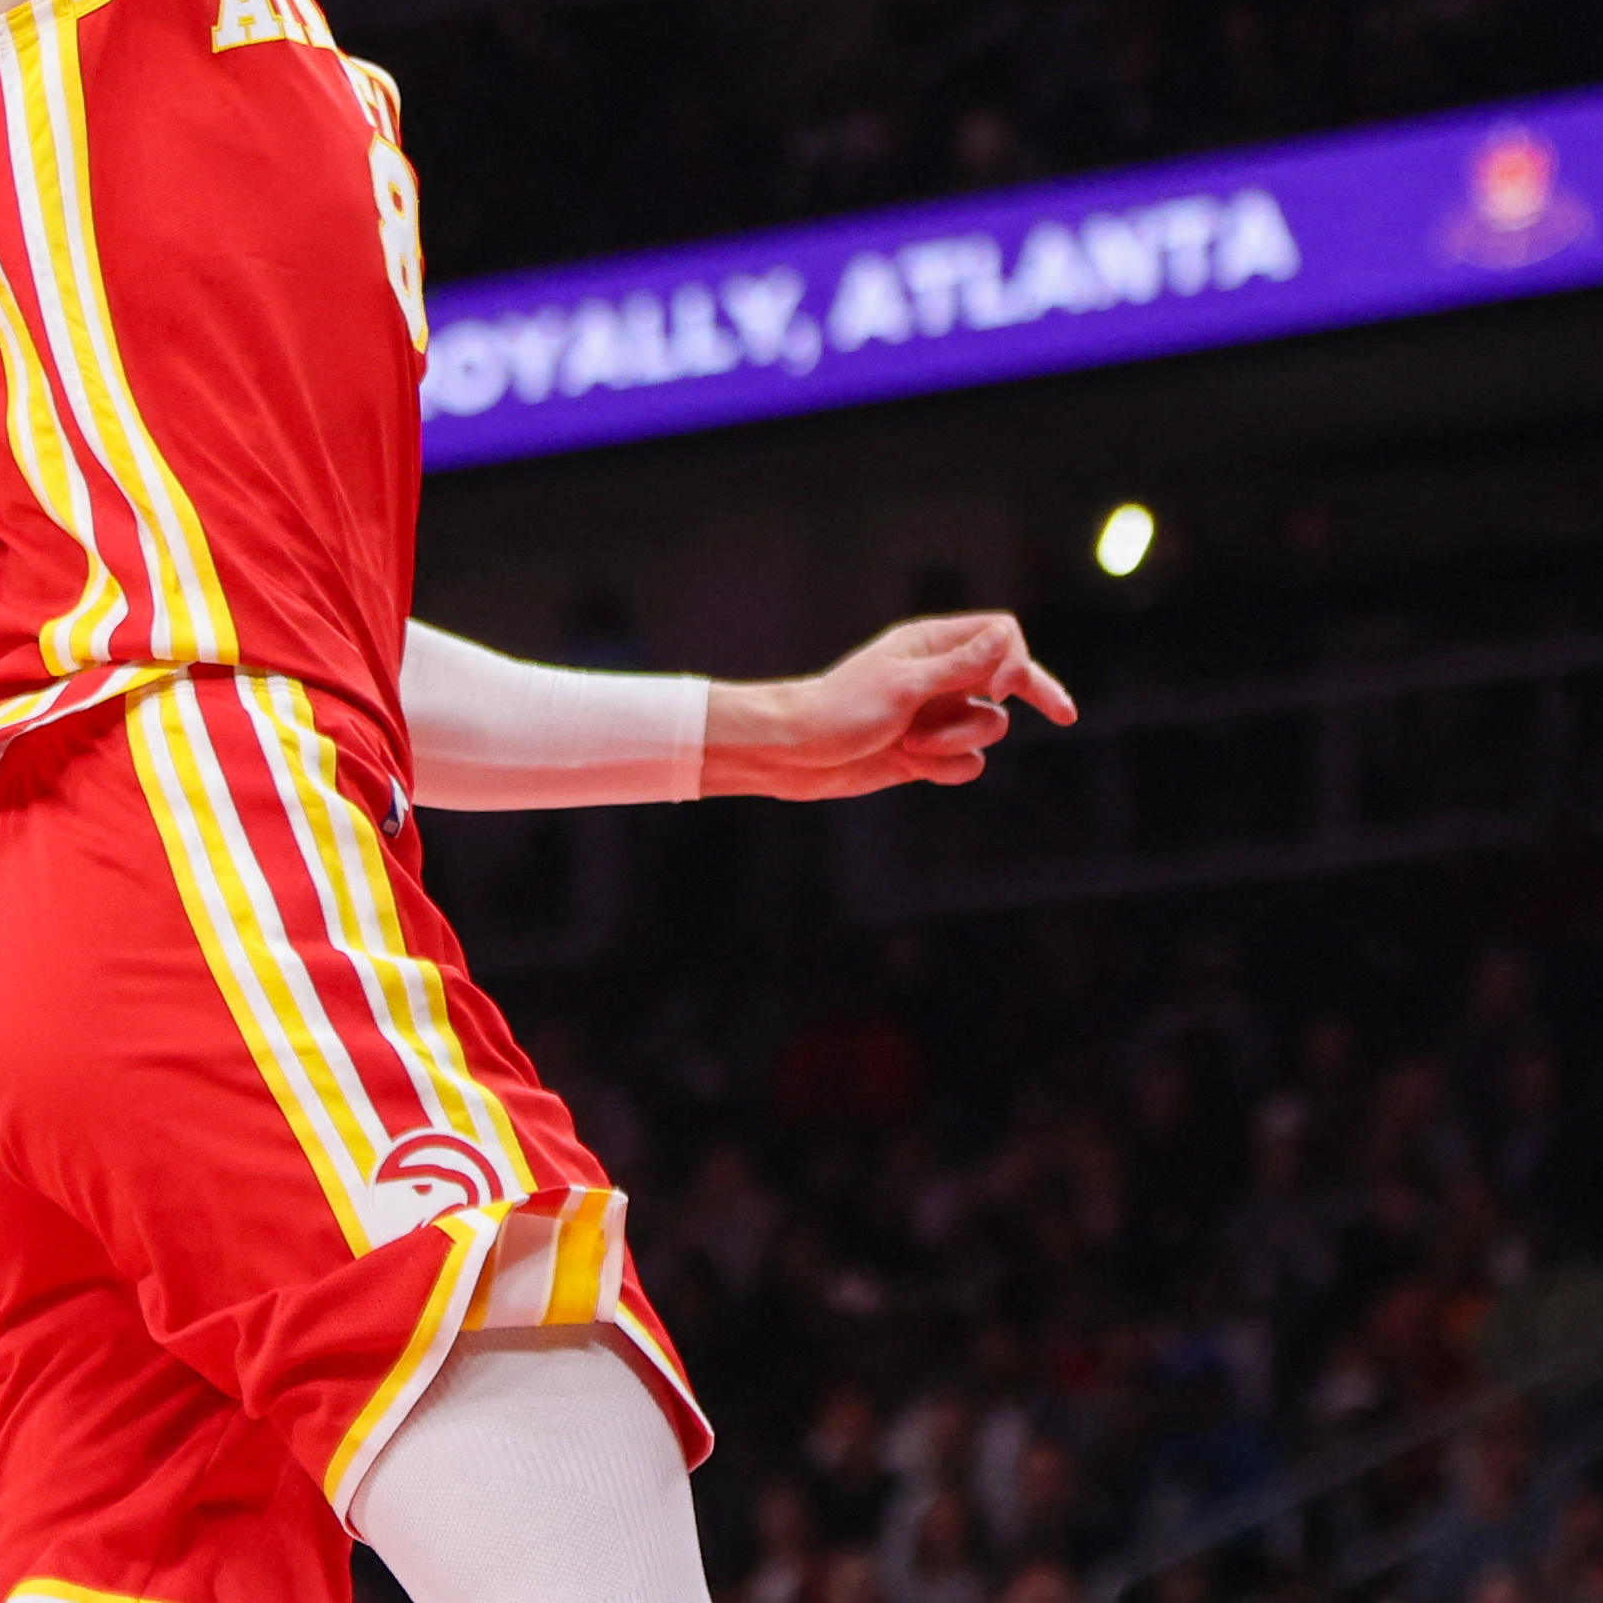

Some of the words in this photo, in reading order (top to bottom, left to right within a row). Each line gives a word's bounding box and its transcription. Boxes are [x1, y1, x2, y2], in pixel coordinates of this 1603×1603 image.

[368, 131, 429, 354] 8
[421, 264, 822, 421] OYALLY,
[827, 189, 1300, 353] ATLANTA
